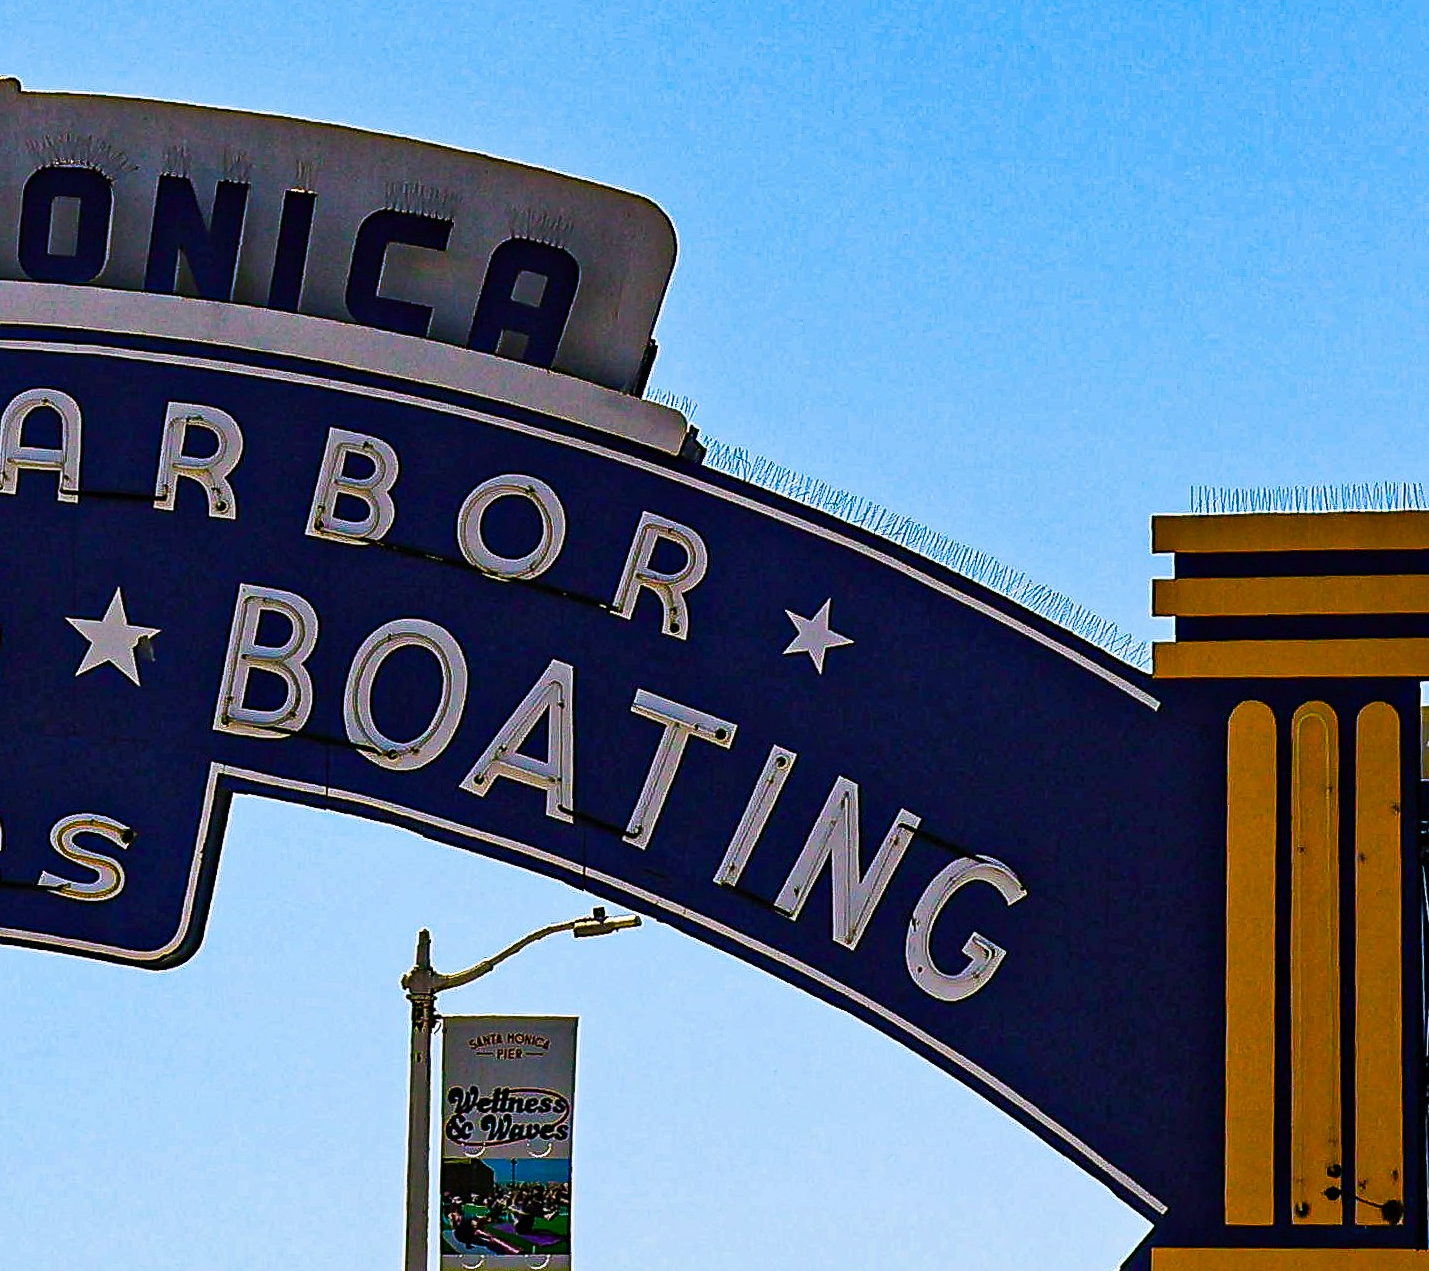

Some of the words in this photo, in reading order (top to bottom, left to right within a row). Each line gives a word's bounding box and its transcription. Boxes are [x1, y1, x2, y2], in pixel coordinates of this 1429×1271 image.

[212, 582, 1028, 1002] BOATING
[497, 1049, 522, 1059] PIER
[447, 1085, 568, 1114] Wellness
[445, 1114, 475, 1140] &
[480, 1114, 570, 1141] Waves
